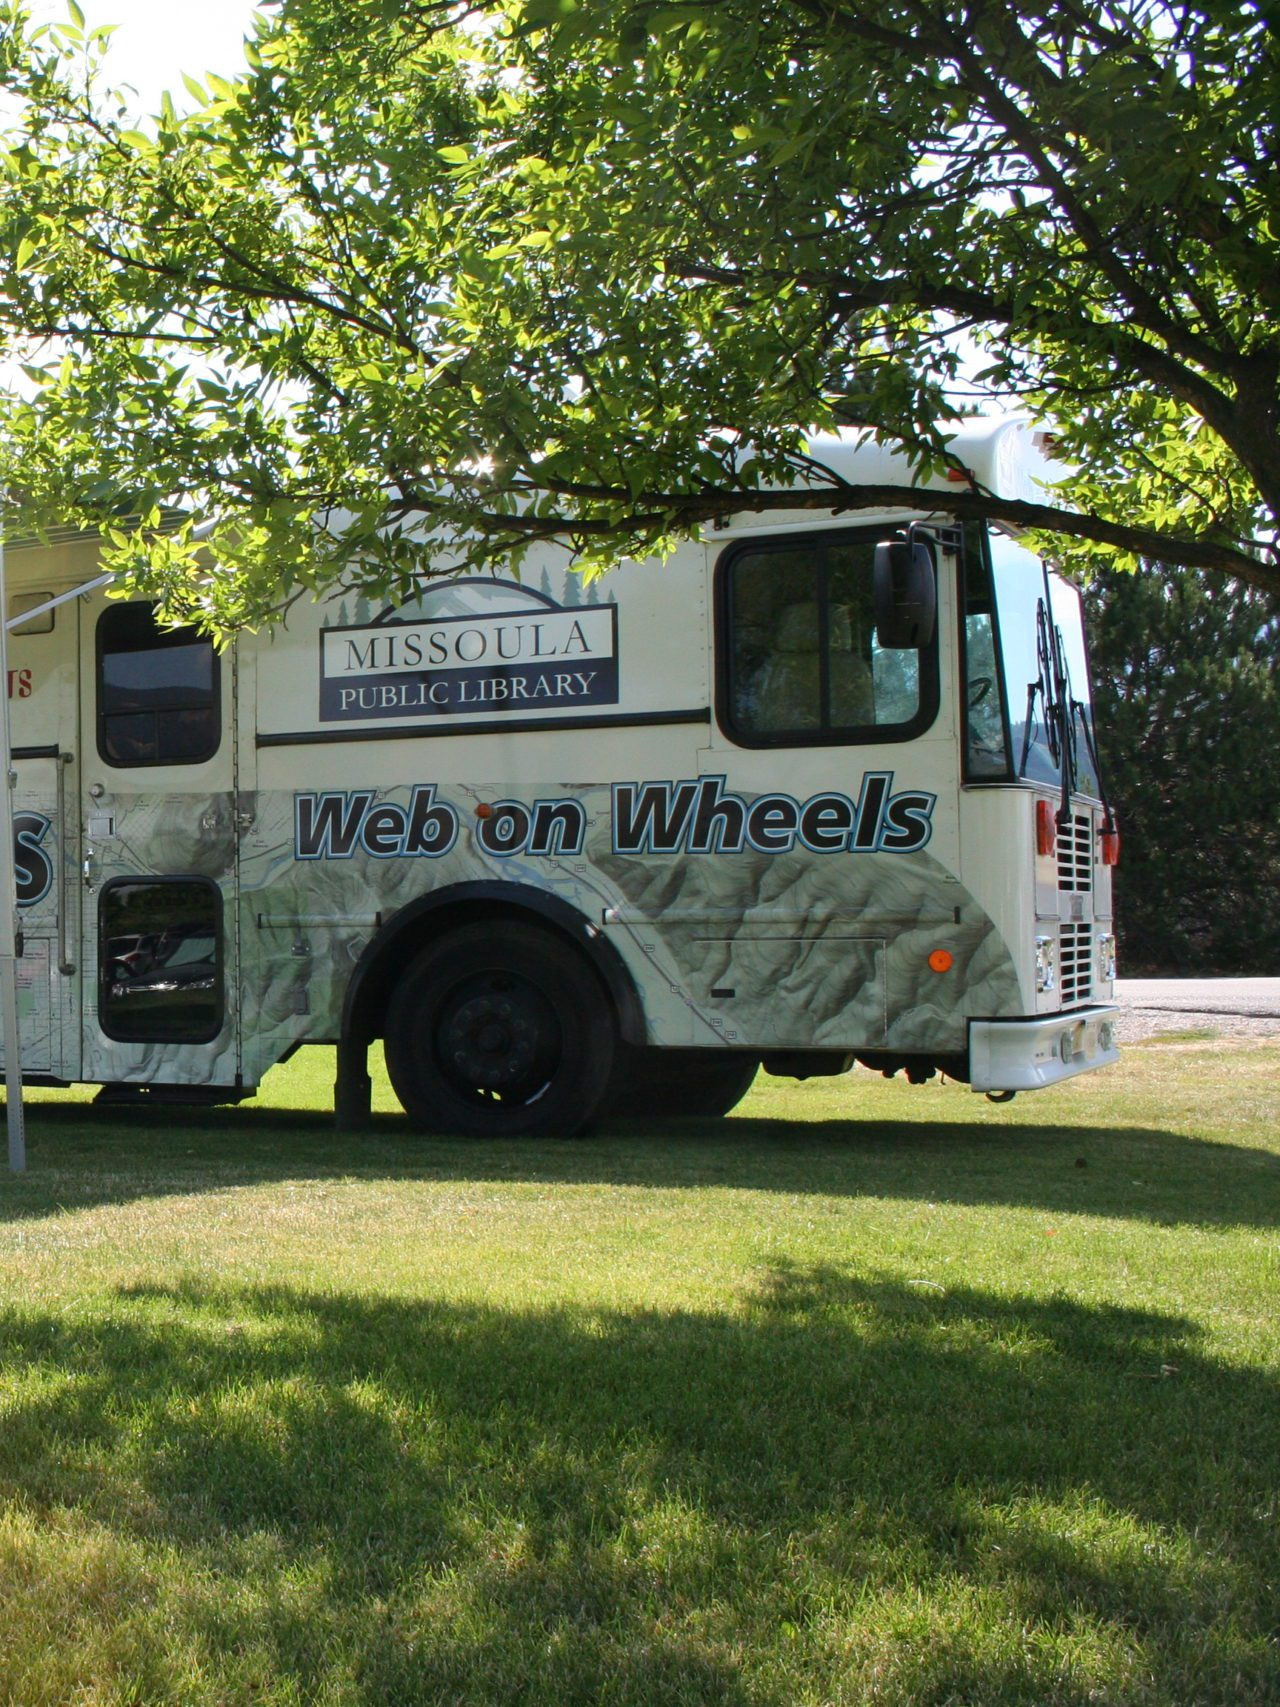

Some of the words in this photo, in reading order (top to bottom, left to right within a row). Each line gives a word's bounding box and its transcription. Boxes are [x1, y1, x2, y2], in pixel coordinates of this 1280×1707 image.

[344, 620, 592, 670] MISSOULA
[339, 681, 449, 710] PUBLIC
[457, 671, 597, 702] LIBRARY
[293, 783, 460, 860] Web
[476, 798, 587, 857] on
[611, 772, 937, 854] Wheels
